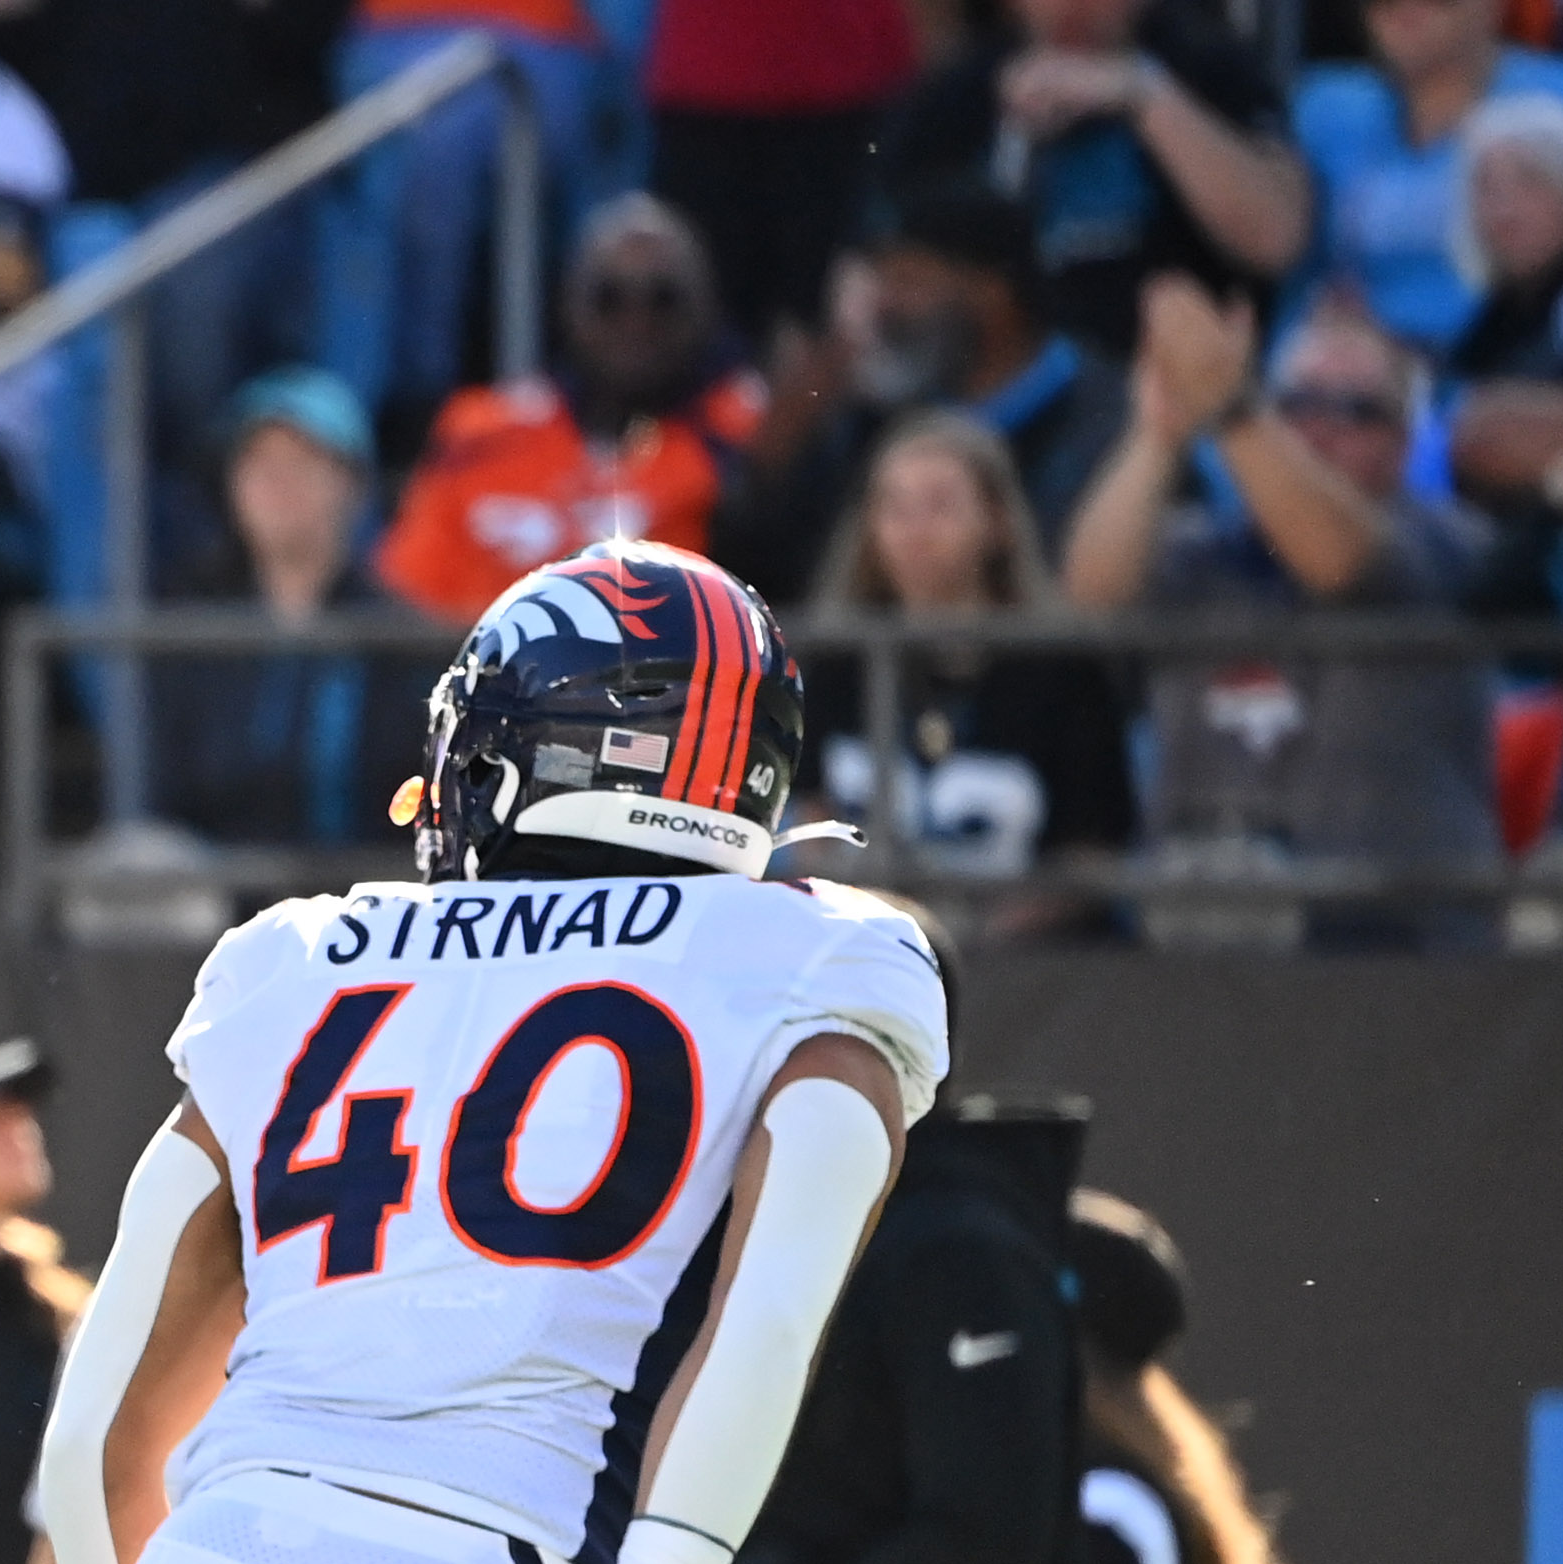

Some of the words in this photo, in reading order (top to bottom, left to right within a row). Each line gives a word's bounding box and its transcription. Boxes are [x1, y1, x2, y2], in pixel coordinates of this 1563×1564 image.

[747, 762, 775, 797] 40
[628, 809, 750, 849] BRONCOS
[327, 883, 682, 965] STRNAD
[252, 979, 703, 1287] 40
